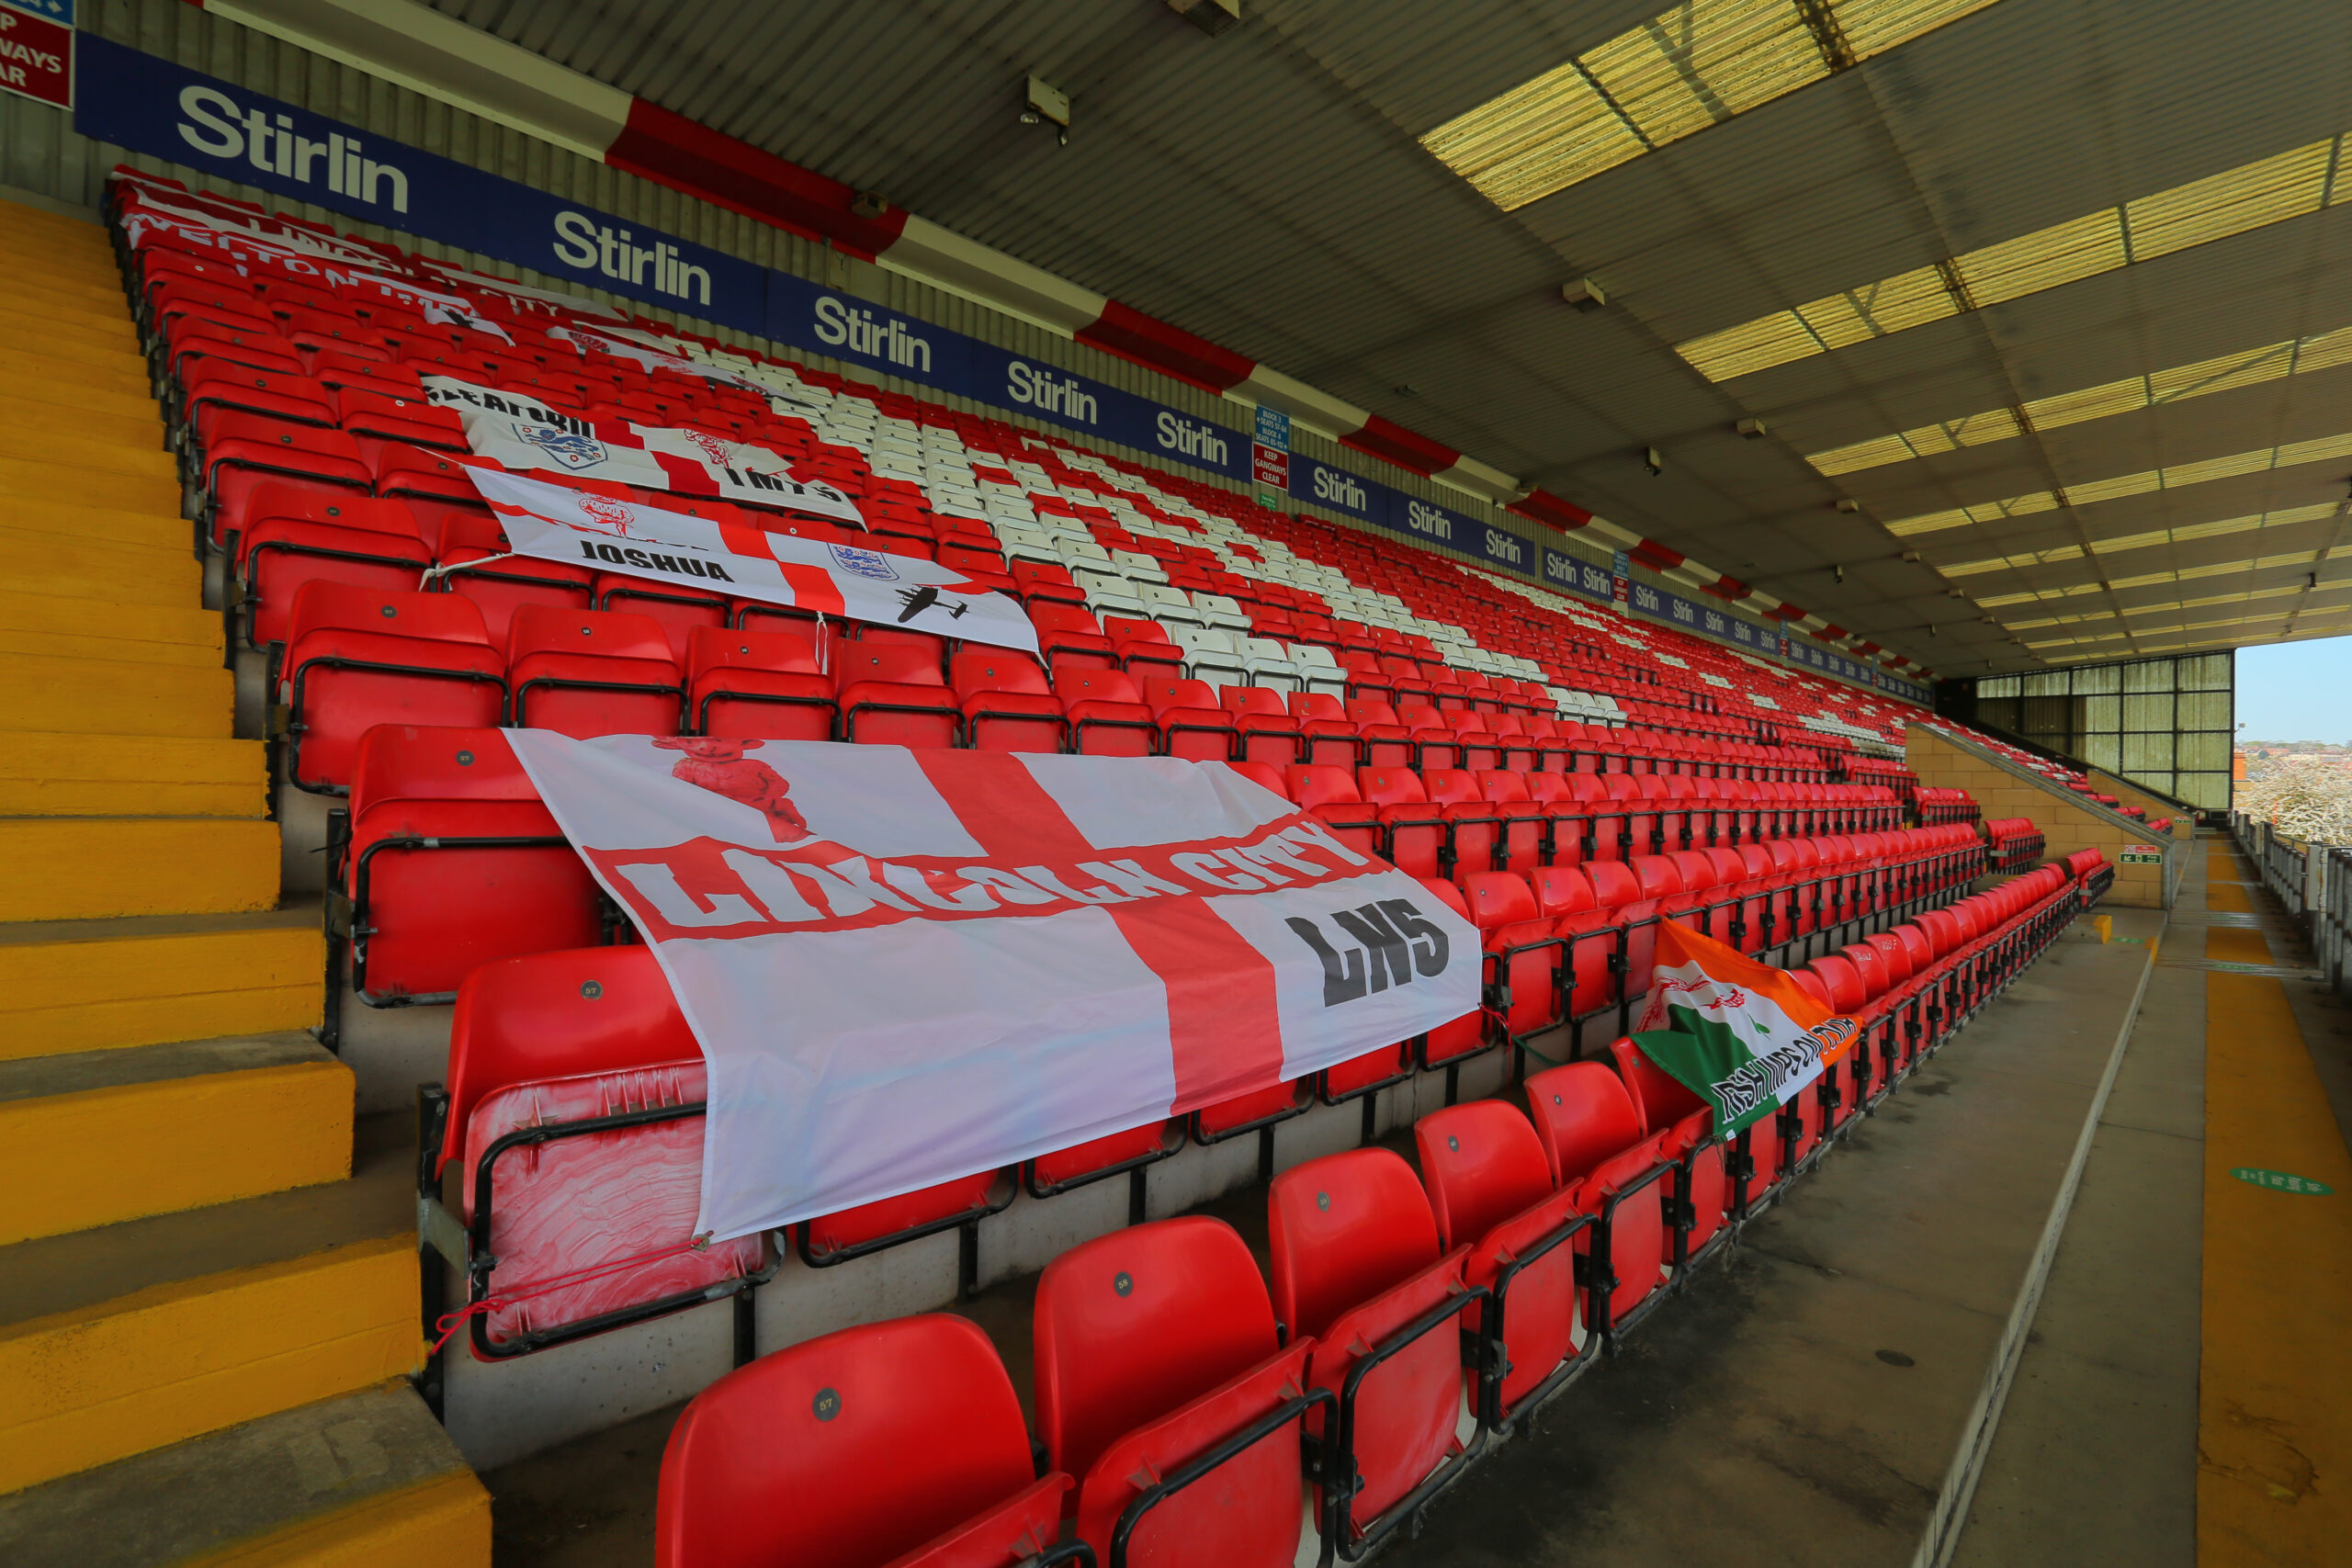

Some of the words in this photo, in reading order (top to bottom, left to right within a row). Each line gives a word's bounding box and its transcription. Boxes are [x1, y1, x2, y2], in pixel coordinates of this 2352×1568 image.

[177, 85, 408, 213] Stirlin
[553, 210, 710, 306] Stirlin
[814, 296, 931, 373] Stirlin
[1007, 360, 1097, 425] Stirlin
[1261, 417, 1273, 428] SEATS
[1262, 427, 1277, 438] BLOCK
[1263, 410, 1277, 422] BLOCK
[1157, 412, 1227, 466] Stirlin
[1264, 449, 1278, 461] KEEP
[1255, 458, 1286, 476] GANGWAYS
[1262, 471, 1280, 484] CLEAR
[1314, 467, 1366, 512] Stirlin
[1408, 501, 1452, 540] Stirlin
[581, 540, 735, 582] JOSHUA
[1486, 529, 1521, 564] Stirlin
[1547, 552, 1577, 584] Stirlin
[1583, 566, 1611, 595] Stirlin
[1636, 585, 1658, 611] Stirlin
[615, 849, 1193, 928] LINCOLN
[1168, 821, 1370, 896] CITY
[1285, 898, 1450, 1009] LN5
[1118, 1279, 1128, 1290] 58
[819, 1397, 832, 1411] 57
